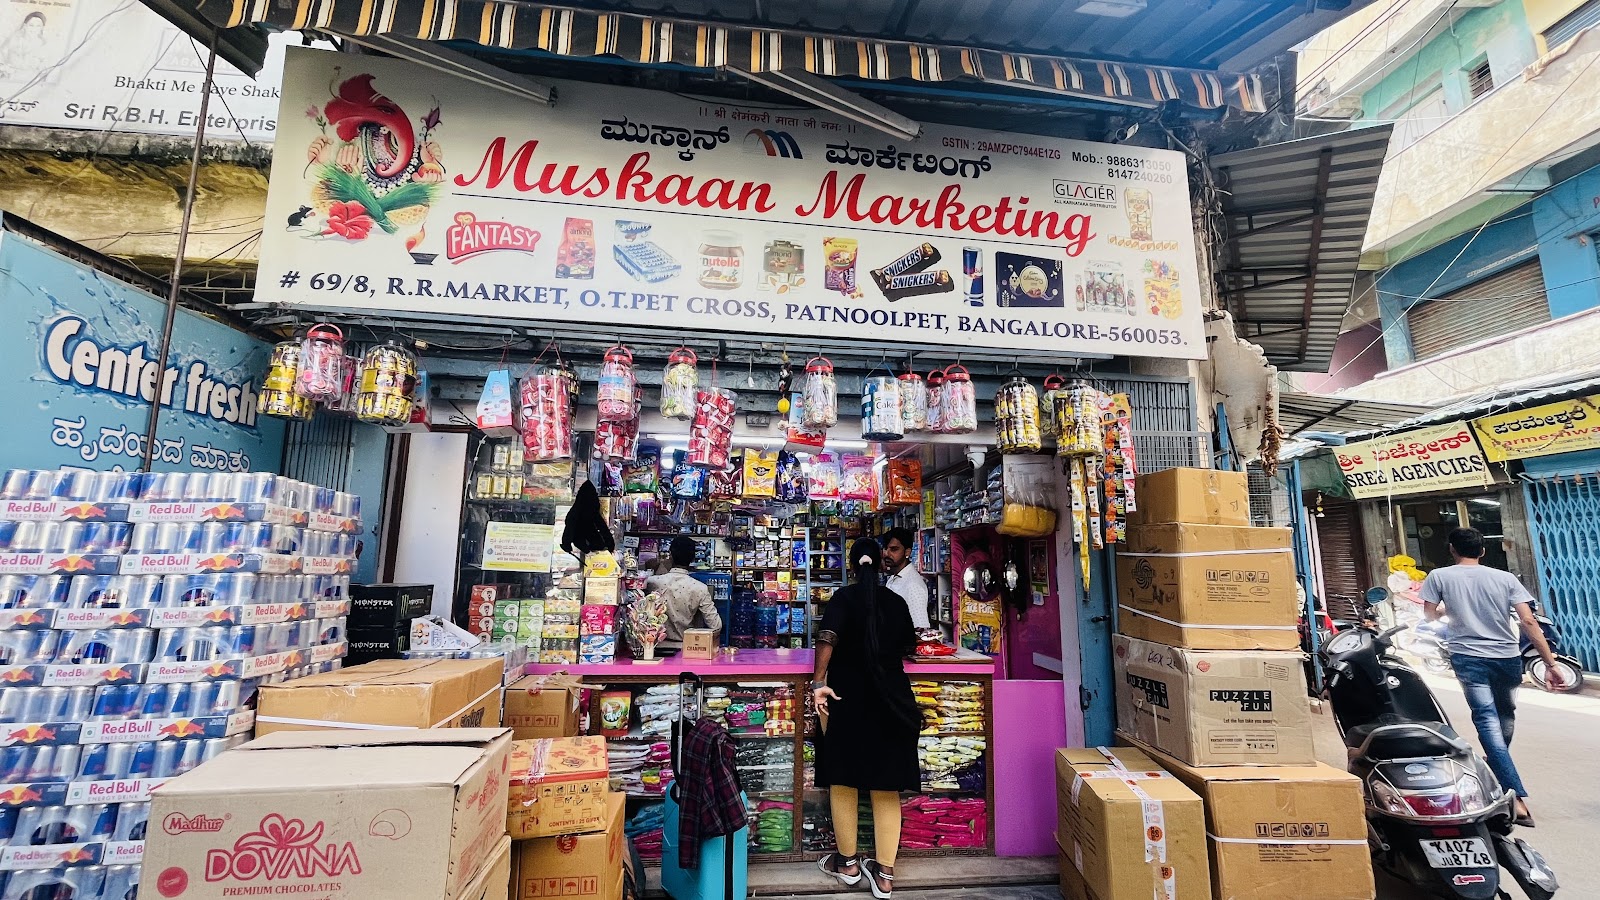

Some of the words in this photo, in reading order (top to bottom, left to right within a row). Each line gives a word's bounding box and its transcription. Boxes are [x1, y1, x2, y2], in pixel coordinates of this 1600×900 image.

[114, 76, 166, 91] Bhakti
[171, 80, 195, 93] Me
[242, 85, 280, 98] Shak
[64, 104, 95, 120] Sri
[102, 106, 169, 126] R.B.H.
[714, 108, 726, 118] श्री
[775, 116, 799, 127] माता
[804, 118, 816, 129] जी
[601, 115, 730, 161] ಮುಸ್ಕಾನ್
[826, 139, 992, 178] ಮಾರ್ಕೆಟಿಂಗ್
[942, 136, 970, 150] GSTIN
[1106, 156, 1172, 172] 9886313050
[1108, 168, 1173, 184] 8147240260
[453, 136, 776, 213] Muskaan
[796, 170, 1096, 258] Marketing
[451, 222, 540, 254] FANTASY
[702, 256, 740, 267] nutella
[884, 250, 921, 276] SNICKERS
[892, 273, 936, 288] SNICKERS
[280, 271, 300, 289] #
[309, 273, 376, 297] 69/8,
[386, 277, 570, 309] R.R.MARKET,
[579, 289, 679, 312] O.T.PET
[686, 297, 777, 322] CROSS,
[785, 304, 950, 334] PATNOOLPET,
[958, 315, 1188, 347] BANGALORE-560053.
[46, 318, 179, 406] Center
[186, 361, 257, 427] fresh
[876, 401, 896, 410] Cake
[1338, 454, 1363, 472] ಶ್ರೀ
[1346, 470, 1388, 488] SREE
[1392, 454, 1484, 482] AGENCIES
[7, 502, 30, 512] Red
[33, 502, 56, 512] Bull
[149, 504, 172, 514] Red
[174, 504, 195, 514] Bull
[20, 555, 43, 565] Bull
[141, 556, 165, 566] Red
[167, 555, 190, 565] Bull
[67, 613, 85, 621] Red
[255, 606, 268, 615] Red
[269, 605, 282, 614] Bull
[1147, 693, 1167, 707] FUN
[1212, 692, 1270, 700] PUZZLE
[102, 722, 126, 734] Red
[128, 721, 152, 733] Bull
[89, 782, 114, 795] Red
[116, 781, 140, 793] Bull
[168, 815, 224, 830] Madhur
[549, 819, 574, 827] CONTENTS
[116, 846, 134, 855] Red
[1434, 840, 1474, 853] KA02
[206, 842, 362, 882] DOVANA
[222, 886, 273, 897] PREMIUM
[275, 882, 342, 894] CHOCOLATES
